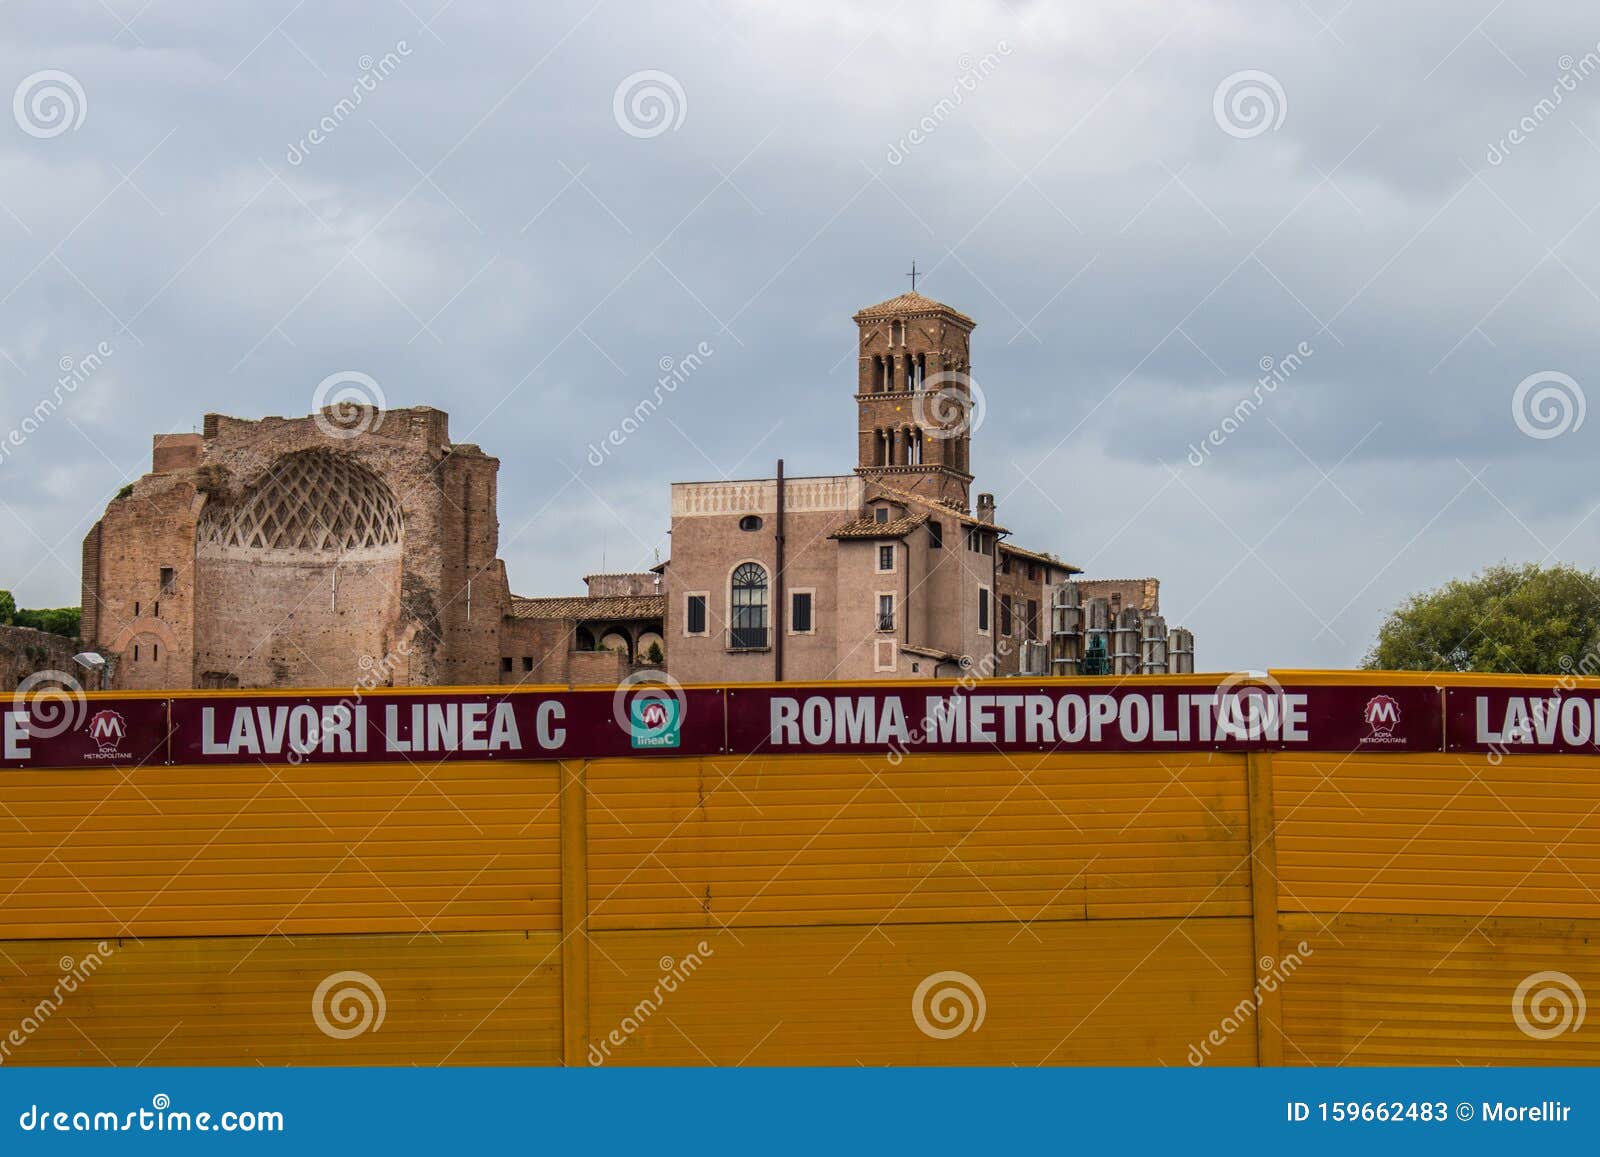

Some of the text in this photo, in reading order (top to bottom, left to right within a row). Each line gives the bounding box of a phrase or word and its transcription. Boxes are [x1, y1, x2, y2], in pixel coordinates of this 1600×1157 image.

[4, 711, 31, 759] E
[202, 700, 567, 754] LAVORI LINEA C
[637, 733, 674, 745] lineaC
[770, 694, 1308, 745] ROMA METROPOLITANE
[1476, 696, 1600, 746] LAVO
